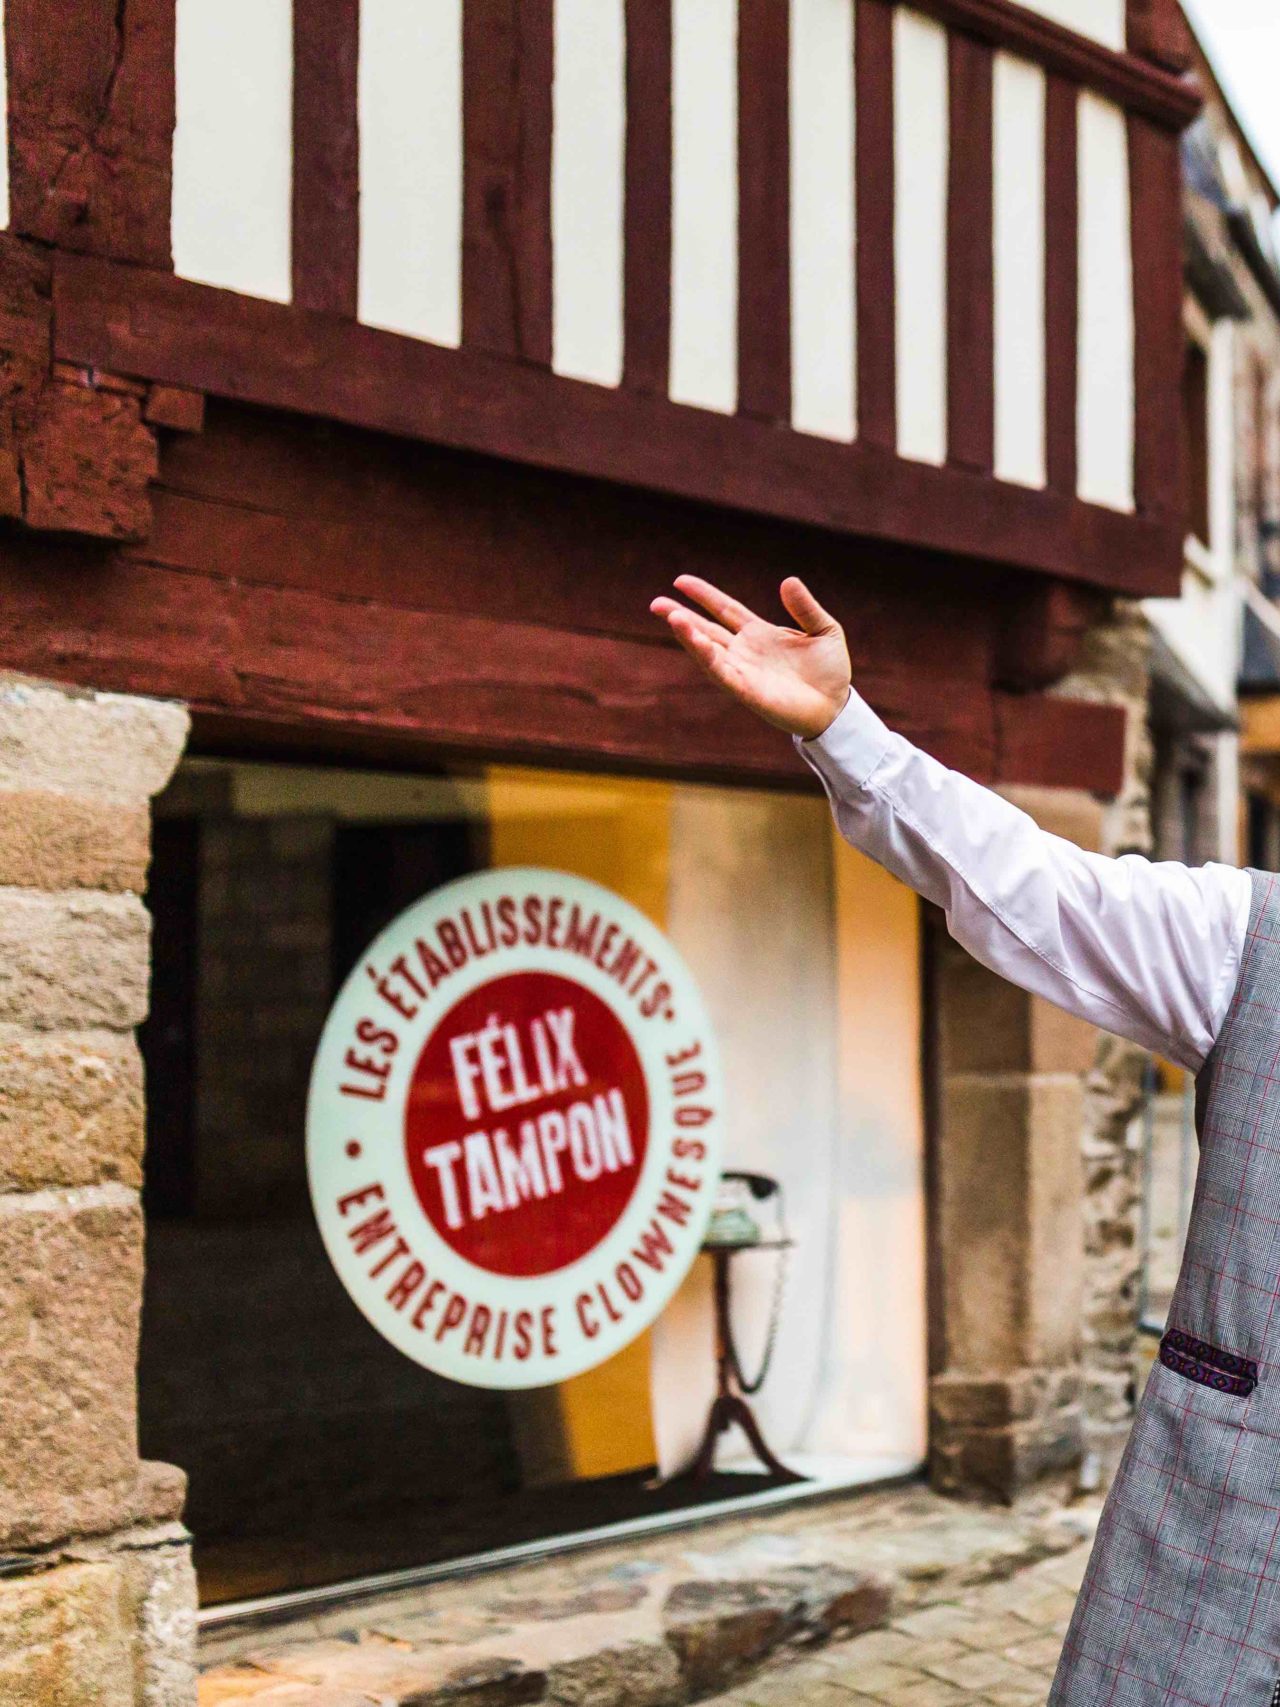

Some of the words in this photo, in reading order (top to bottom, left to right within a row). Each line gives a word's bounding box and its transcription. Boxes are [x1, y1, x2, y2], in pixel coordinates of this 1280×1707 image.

[340, 1017, 399, 1102] LES
[450, 1009, 587, 1120] FÉLIX
[338, 1183, 558, 1362] ENTREPRISE
[575, 1039, 715, 1340] CLOWNESQUE
[424, 1088, 634, 1230] TAMPON
